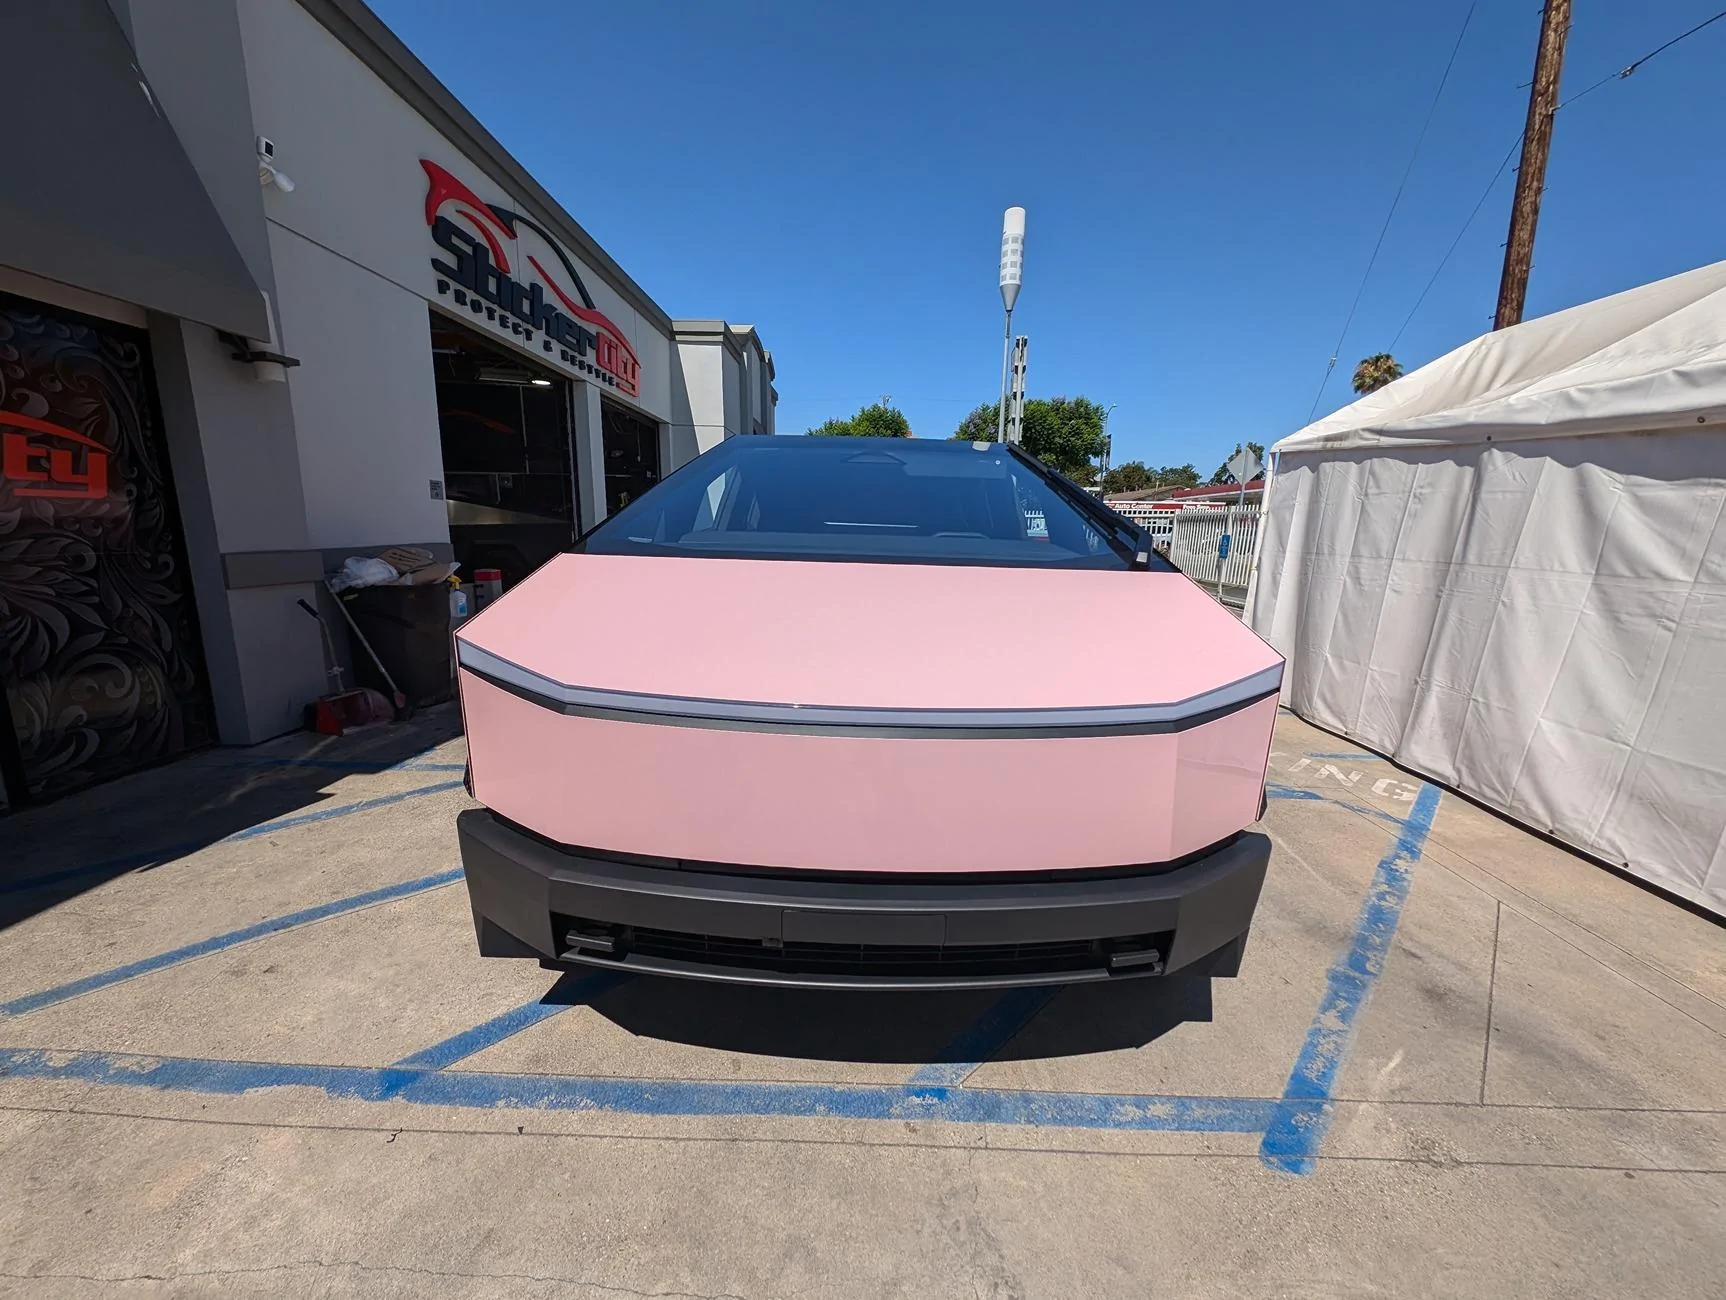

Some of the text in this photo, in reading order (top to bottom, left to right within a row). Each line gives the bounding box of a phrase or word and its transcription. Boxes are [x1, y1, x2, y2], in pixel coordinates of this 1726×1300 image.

[437, 278, 615, 387] PROTECT & RESTYLE
